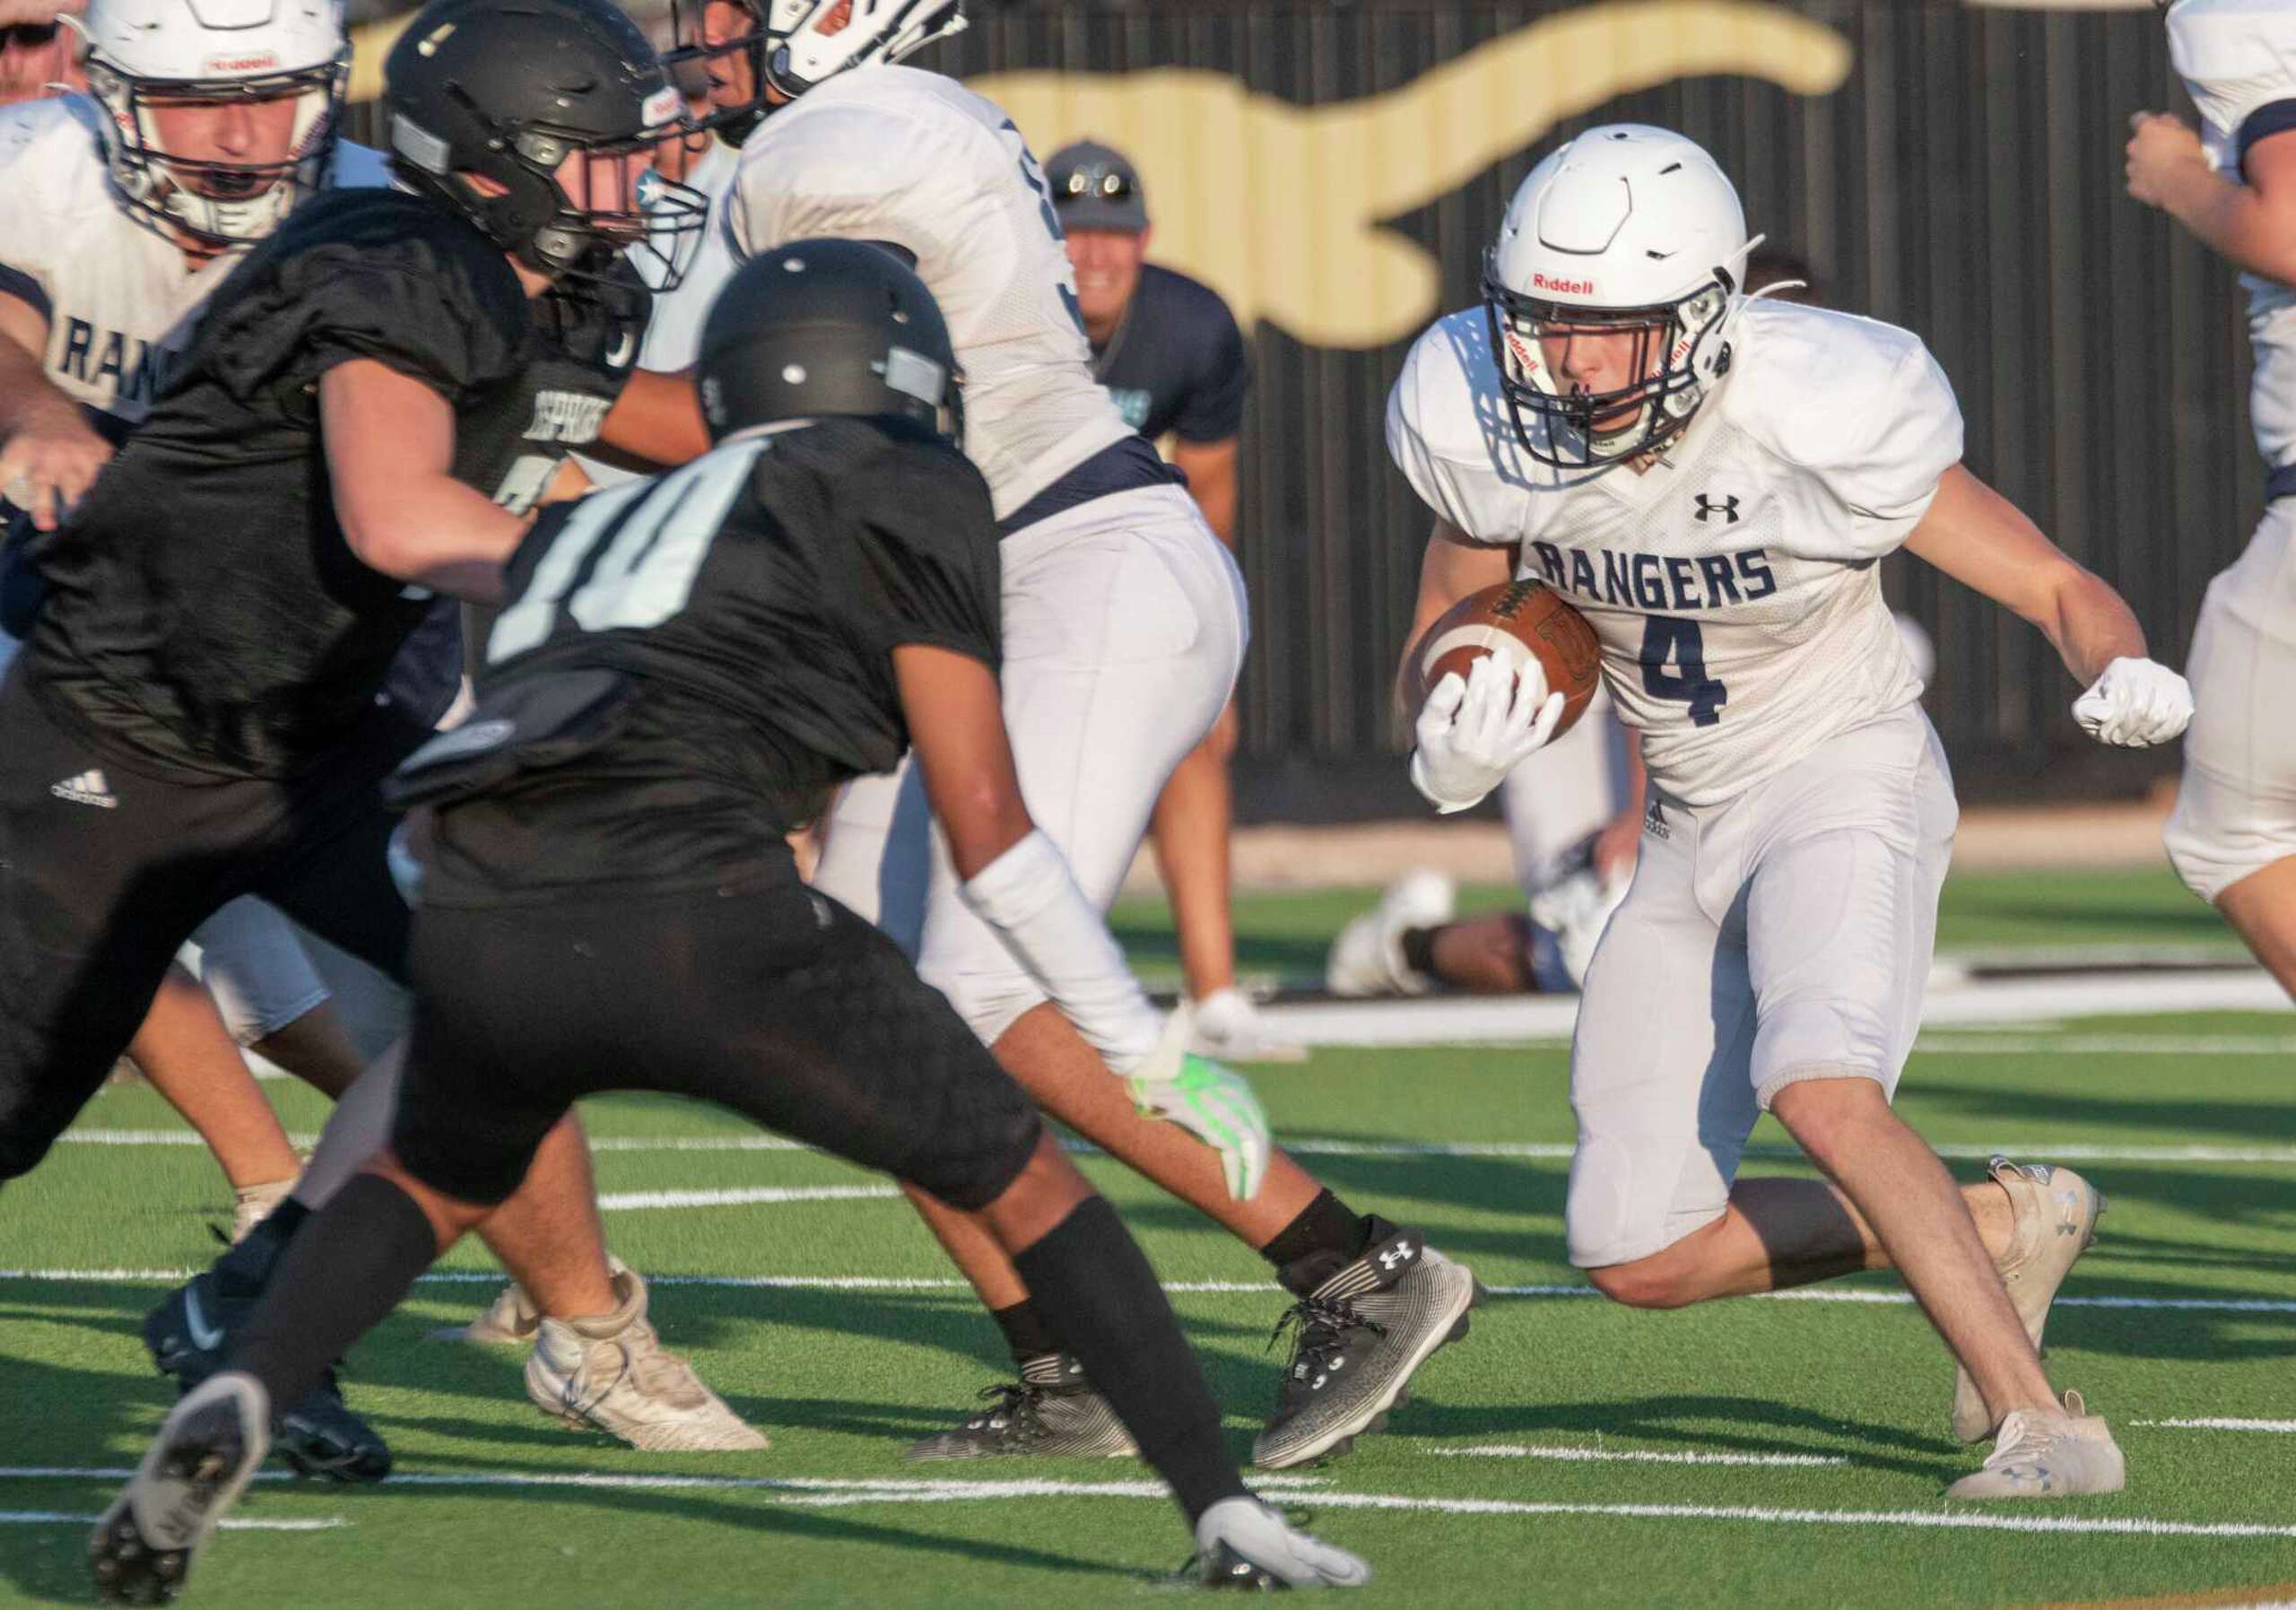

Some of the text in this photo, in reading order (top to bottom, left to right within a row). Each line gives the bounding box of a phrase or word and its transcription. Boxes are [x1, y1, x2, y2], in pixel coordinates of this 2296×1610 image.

[1533, 273, 1594, 295] Riddell
[1531, 541, 1778, 610] RANGERS
[1639, 614, 1727, 727] 4
